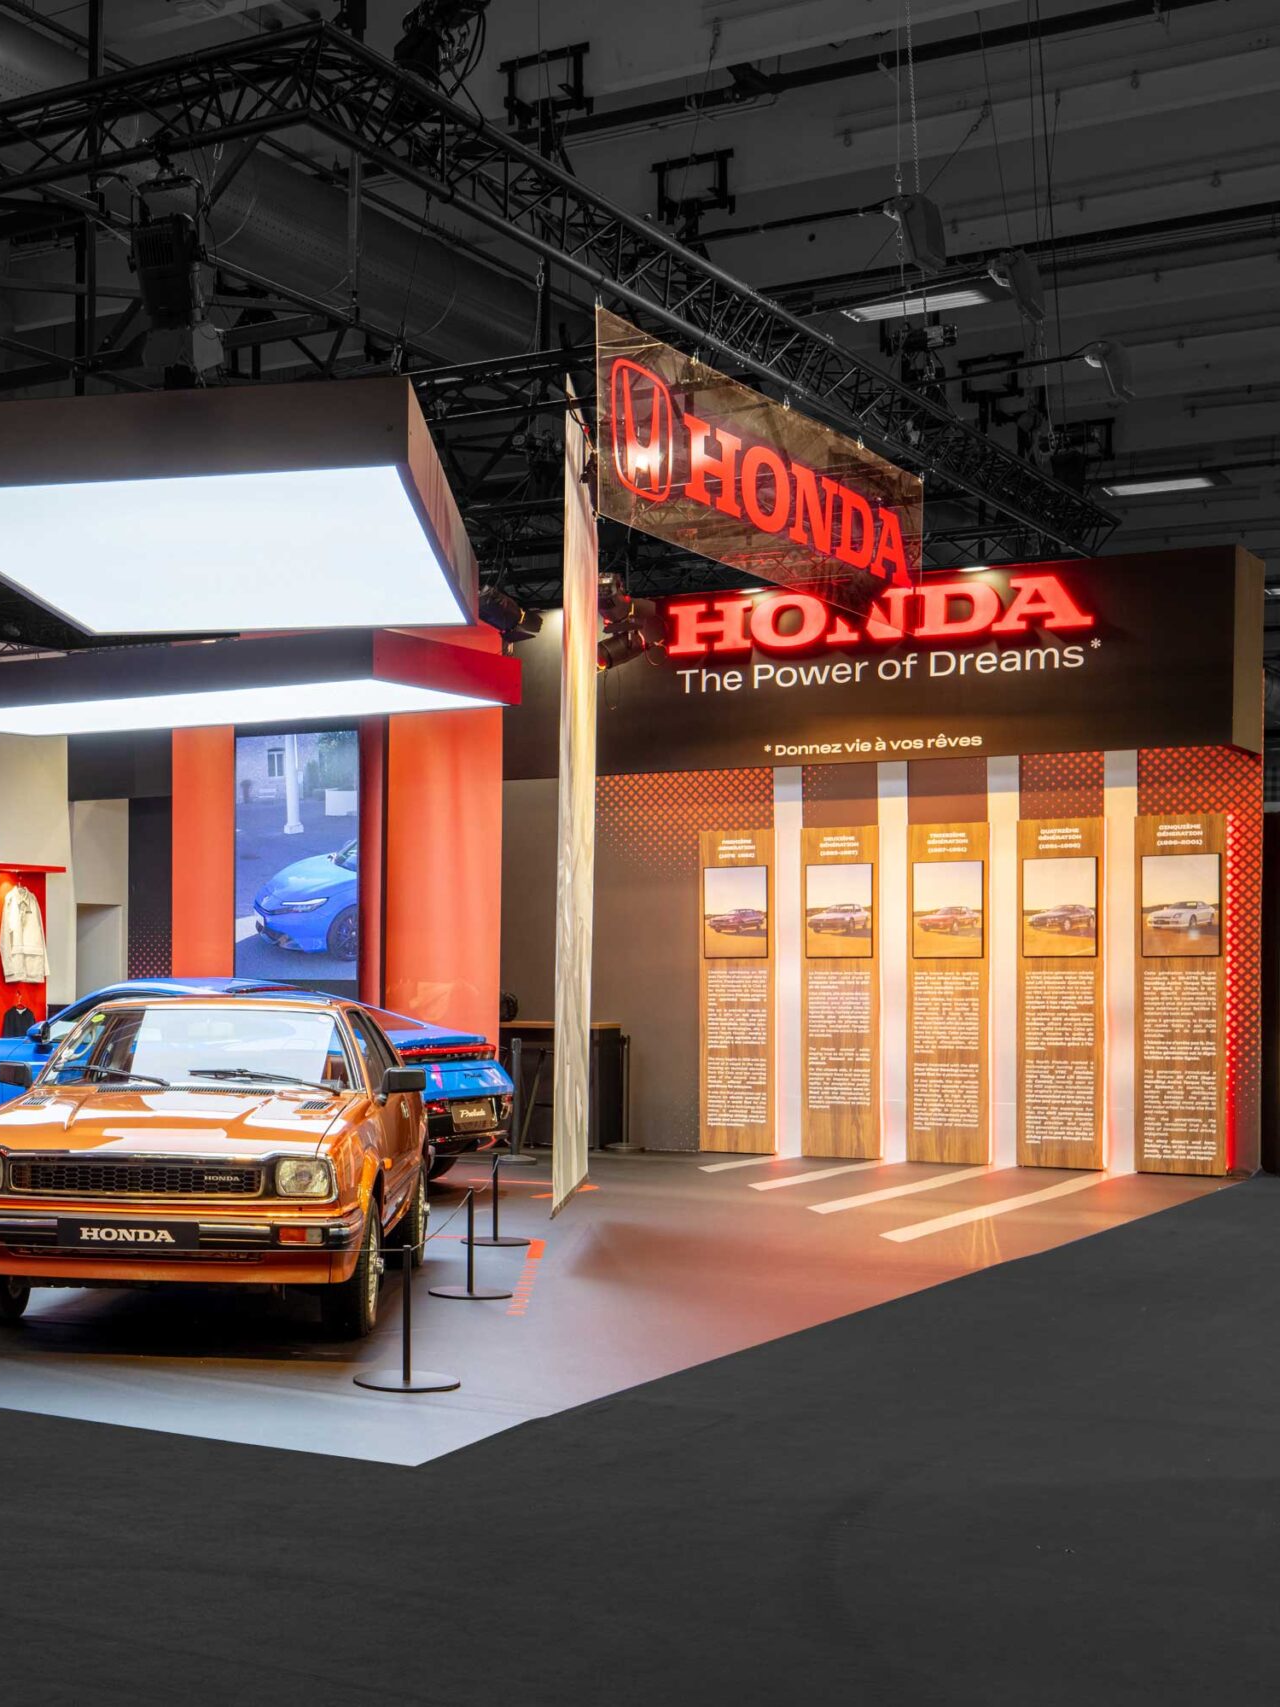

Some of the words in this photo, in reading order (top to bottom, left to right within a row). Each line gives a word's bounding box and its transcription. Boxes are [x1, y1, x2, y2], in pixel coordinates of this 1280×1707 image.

[684, 412, 912, 587] HONDA
[677, 668, 743, 694] The
[753, 661, 869, 690] Power
[877, 652, 918, 681] of
[844, 738, 871, 753] vie
[874, 735, 887, 751] à
[889, 737, 924, 750] vos
[926, 733, 982, 749] rêves
[204, 1174, 241, 1182] HONDA
[79, 1227, 176, 1243] HONDA
